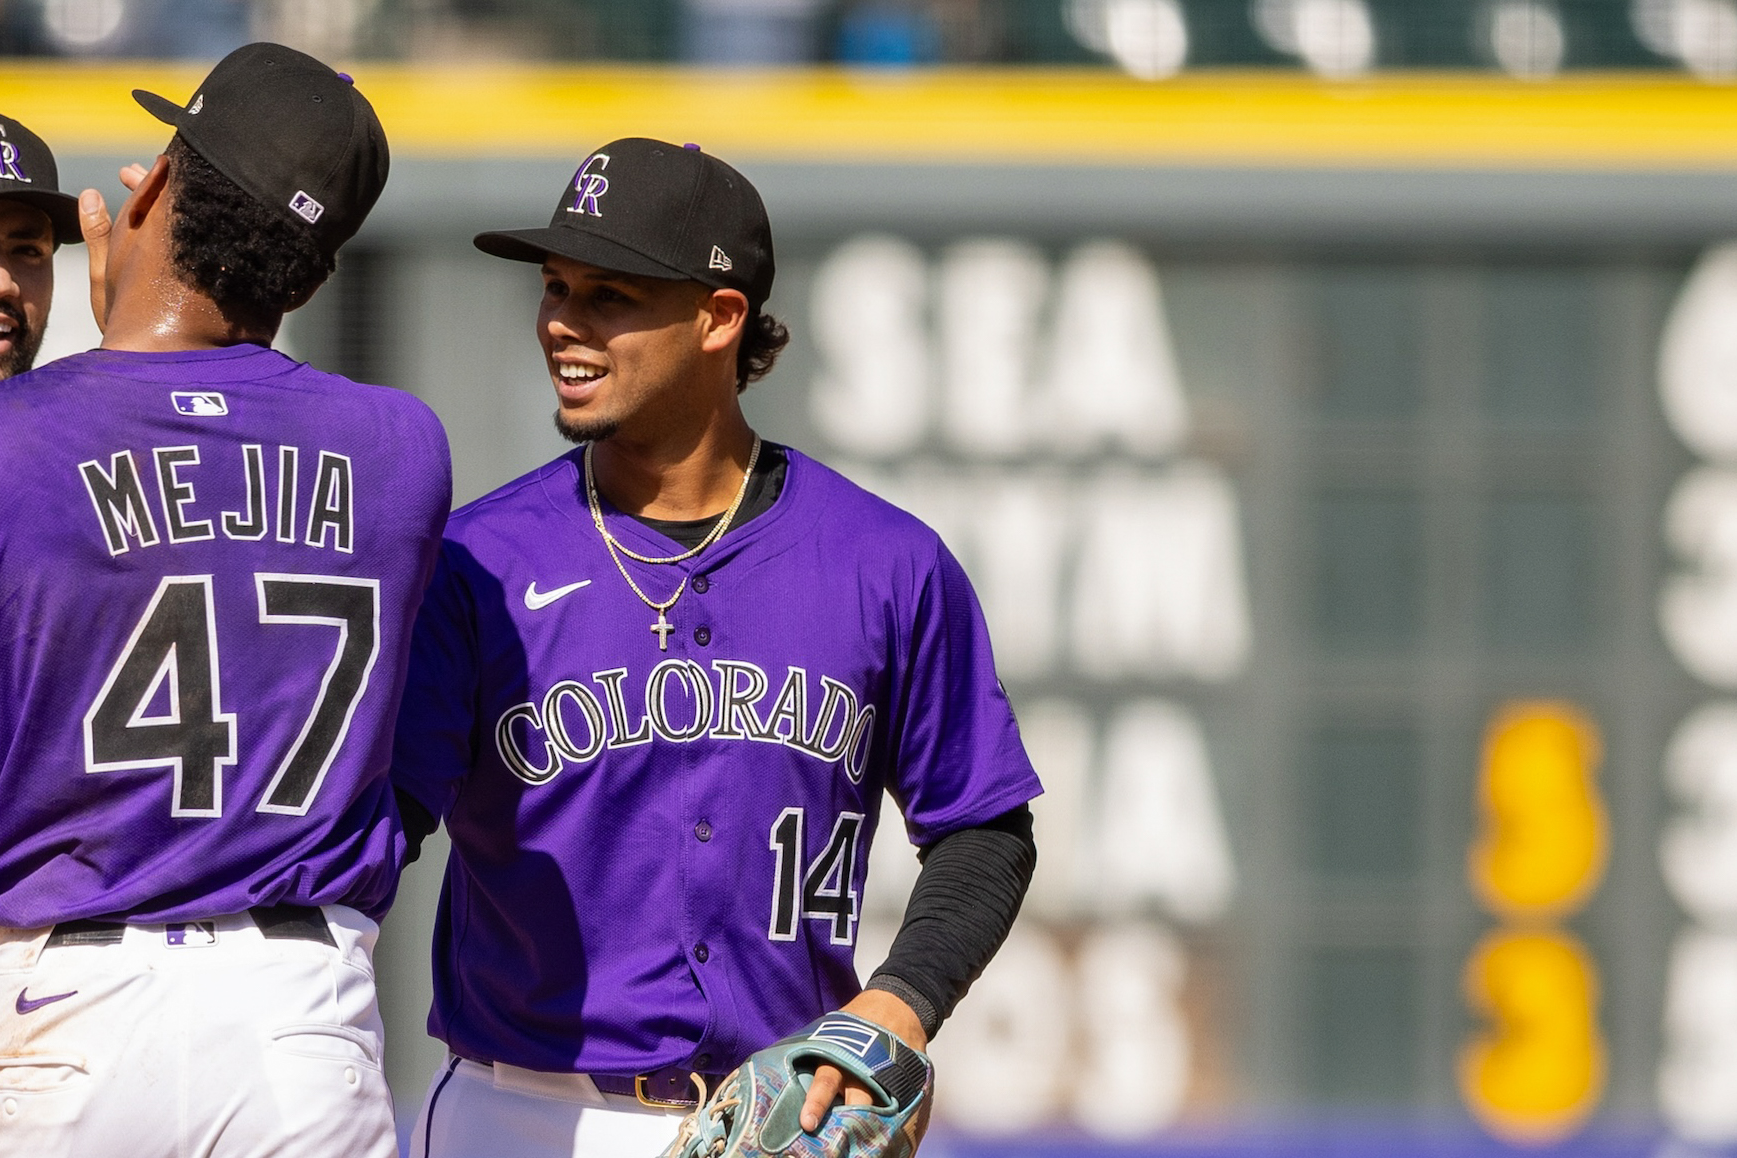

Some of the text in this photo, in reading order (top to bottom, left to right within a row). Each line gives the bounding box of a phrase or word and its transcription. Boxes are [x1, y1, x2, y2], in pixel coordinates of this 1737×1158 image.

[810, 232, 1190, 460] SEA
[78, 443, 354, 557] MEJIA
[853, 455, 1253, 690] YM
[83, 573, 380, 819] 47
[495, 659, 876, 786] COLORADO
[767, 806, 866, 945] 14
